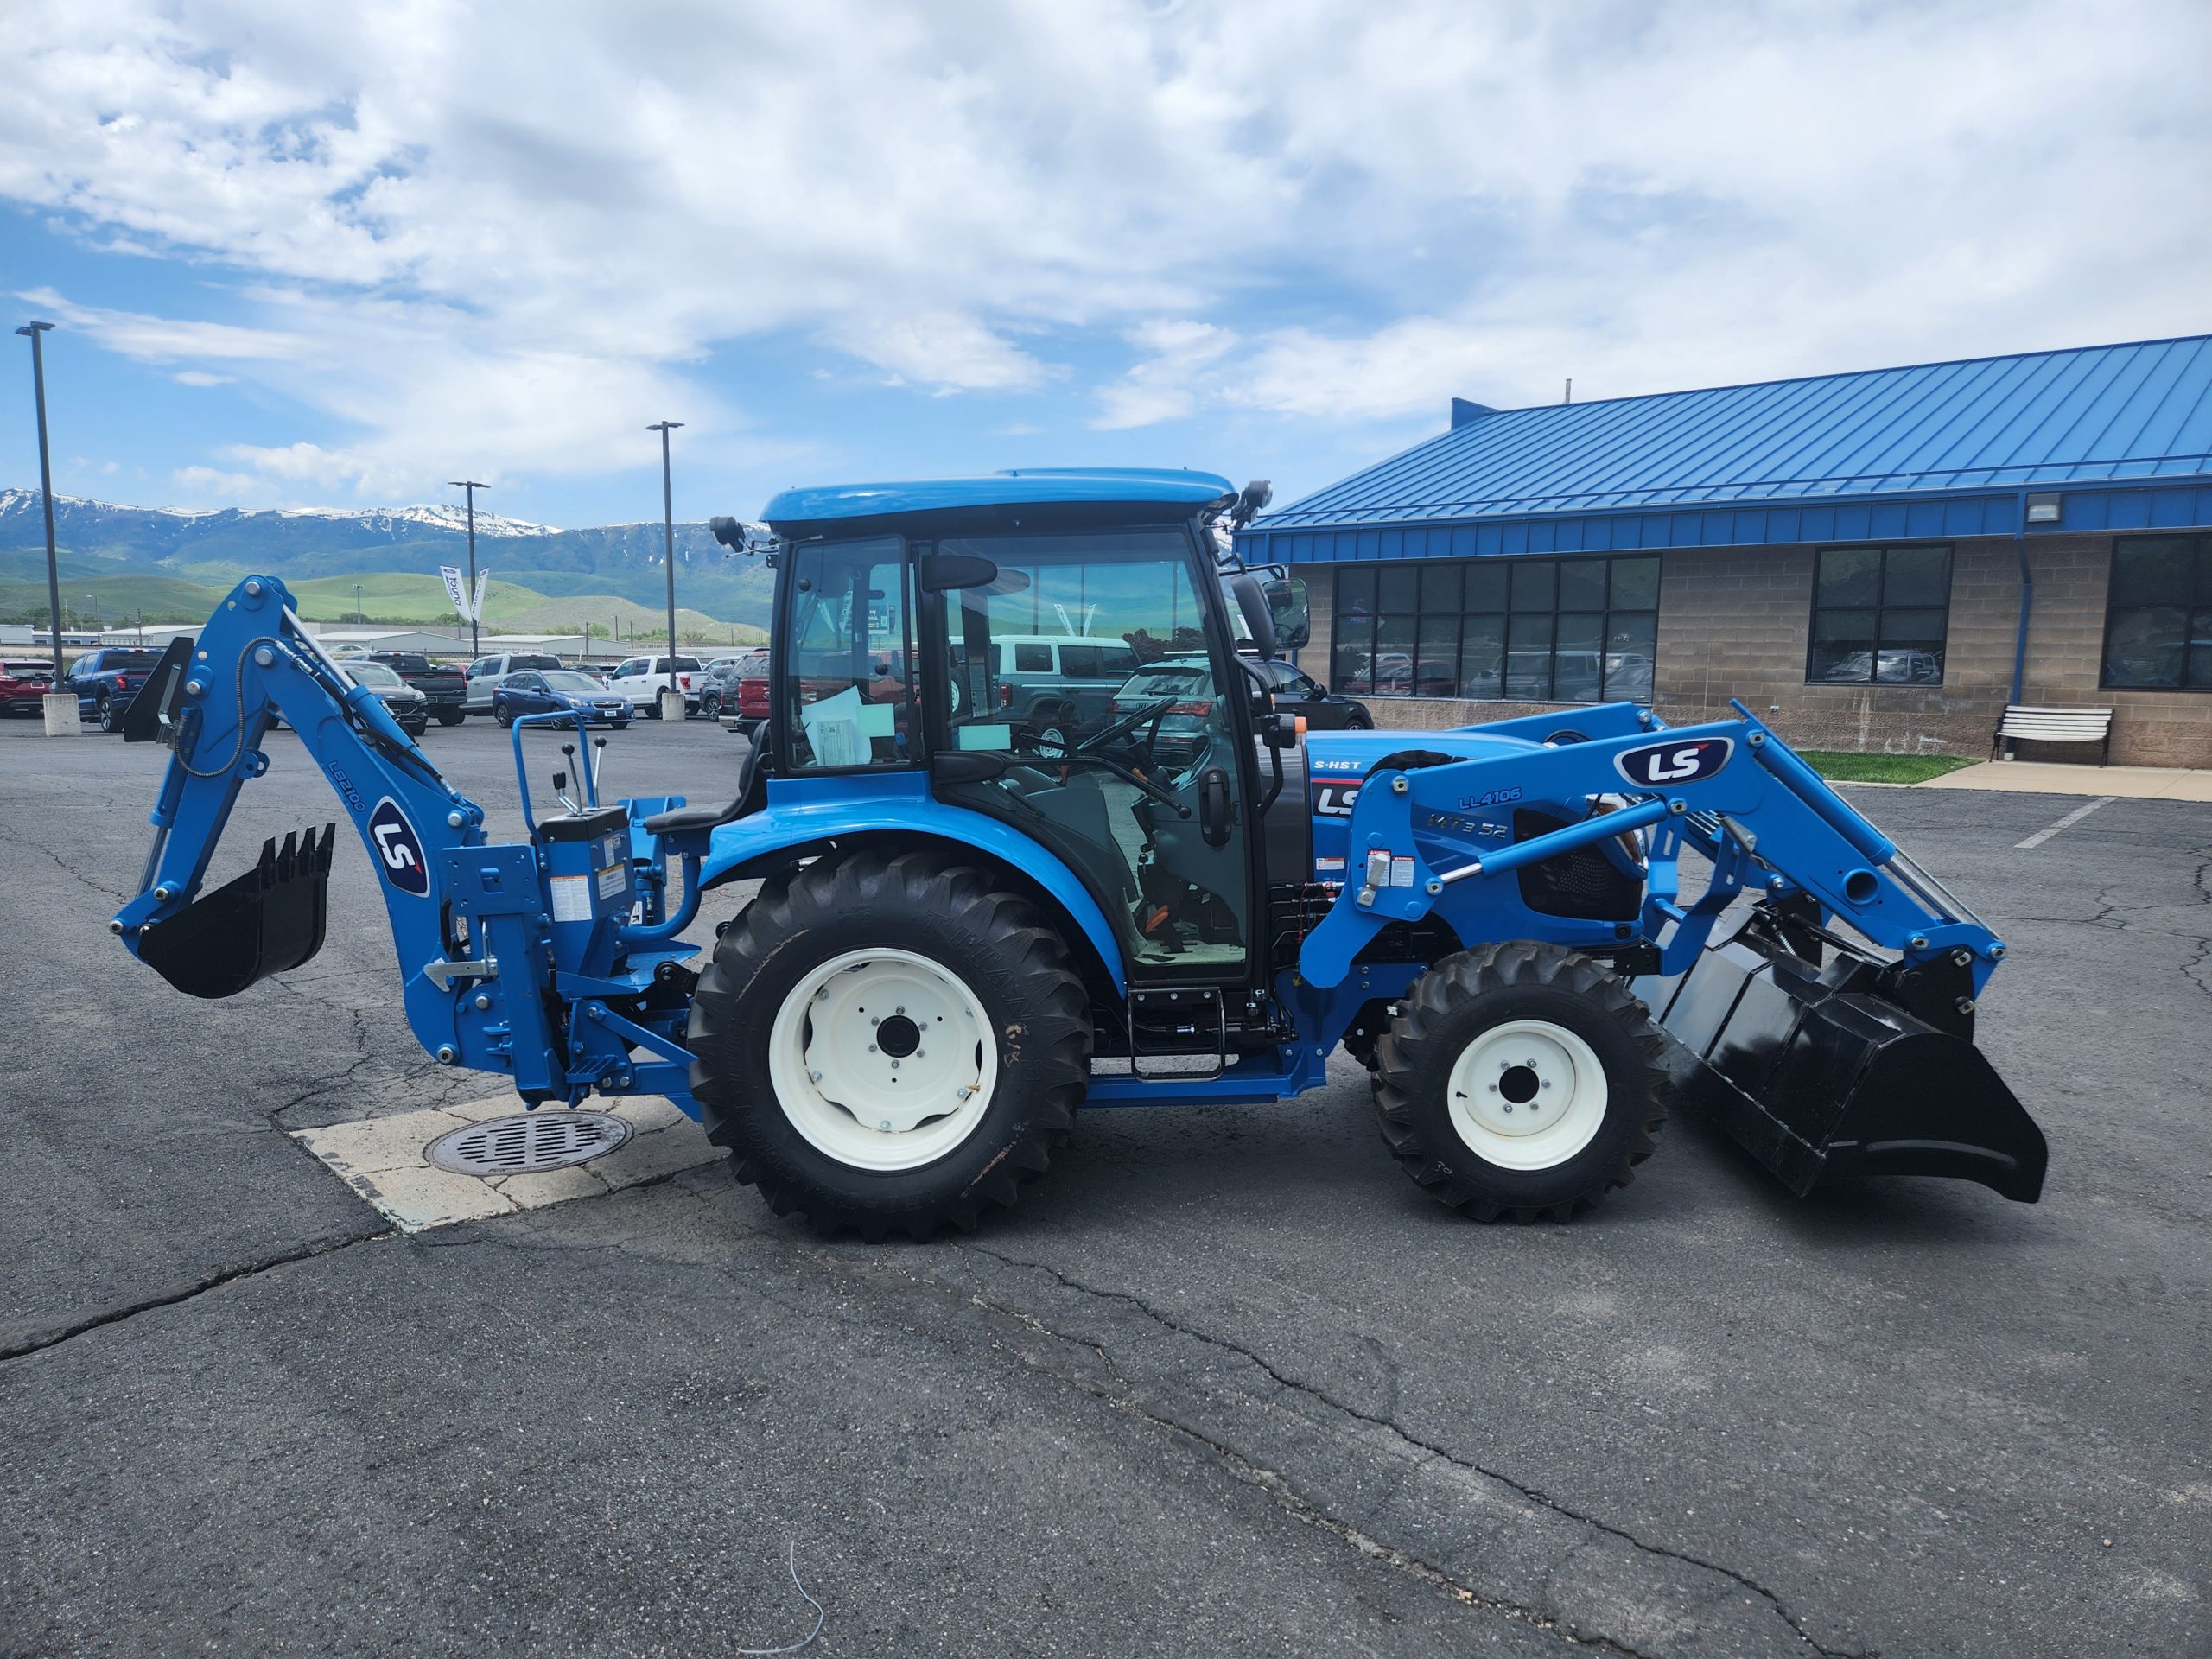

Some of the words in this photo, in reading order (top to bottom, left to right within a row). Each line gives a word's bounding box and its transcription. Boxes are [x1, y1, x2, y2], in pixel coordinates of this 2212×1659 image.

[327, 760, 366, 812] LB2100
[1649, 747, 1700, 781] LS
[1459, 787, 1522, 810] LL4106
[374, 823, 416, 869] LS
[922, 908, 1038, 1021] TITAN
